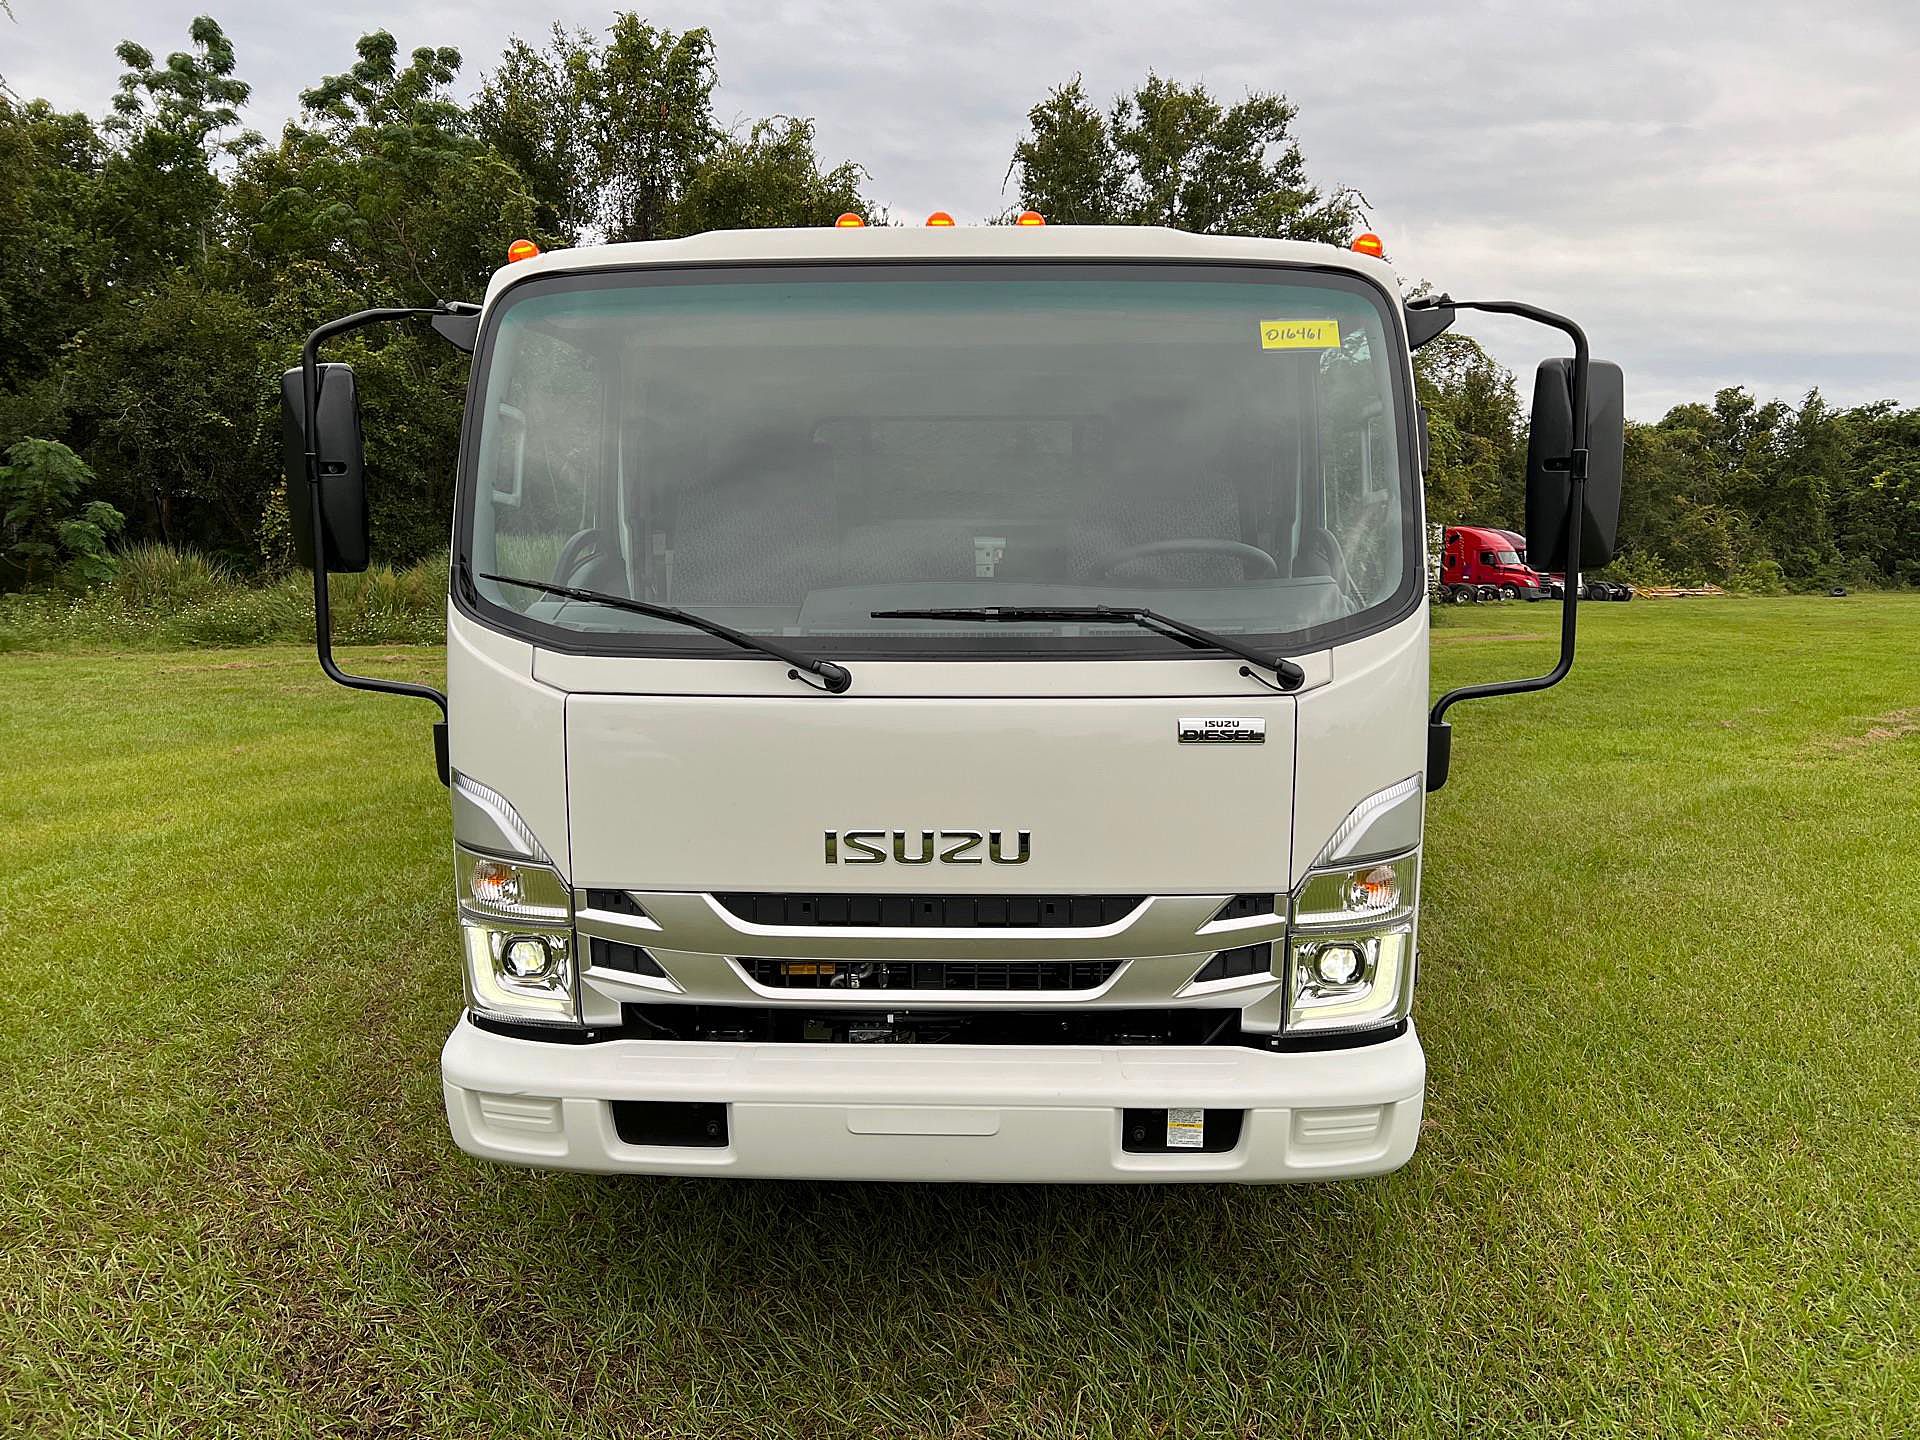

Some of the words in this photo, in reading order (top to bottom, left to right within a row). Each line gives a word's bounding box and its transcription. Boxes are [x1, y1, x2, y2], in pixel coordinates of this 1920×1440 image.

[1205, 720, 1240, 728] ISUZU
[1183, 730, 1262, 741] DIESEL
[824, 829, 1031, 865] ISUZU
